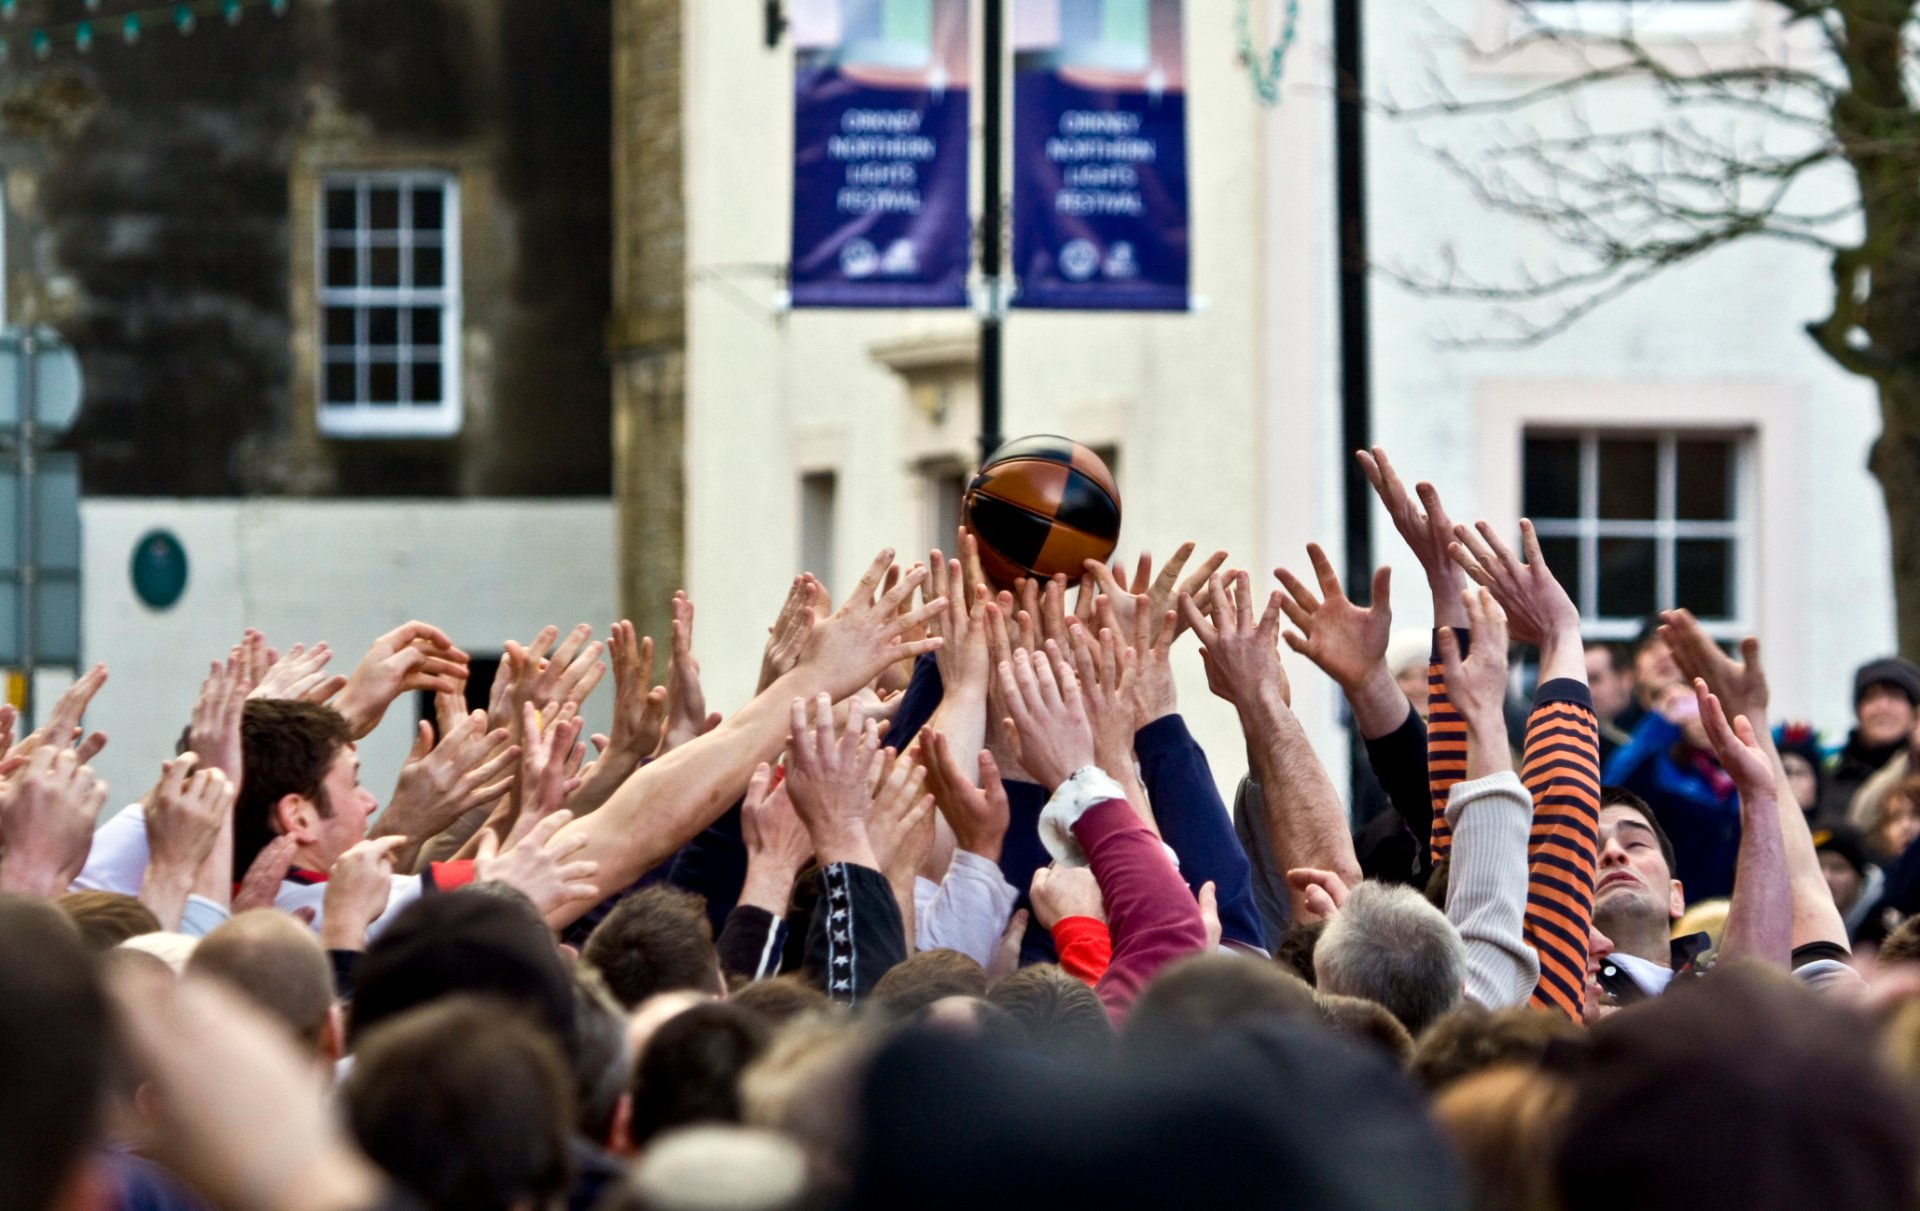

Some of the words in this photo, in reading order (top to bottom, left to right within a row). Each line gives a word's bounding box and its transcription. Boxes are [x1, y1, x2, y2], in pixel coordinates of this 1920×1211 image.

[841, 110, 920, 132] ORKNEY
[1060, 111, 1142, 134] ORKNEY
[829, 136, 935, 160] NORTHERN
[1047, 137, 1156, 160] NORTHERN
[846, 163, 916, 185] LIGHTS
[1065, 163, 1137, 186] LIGHTS
[837, 188, 920, 213] FESTIVAL
[1056, 190, 1143, 215] FESTIVAL
